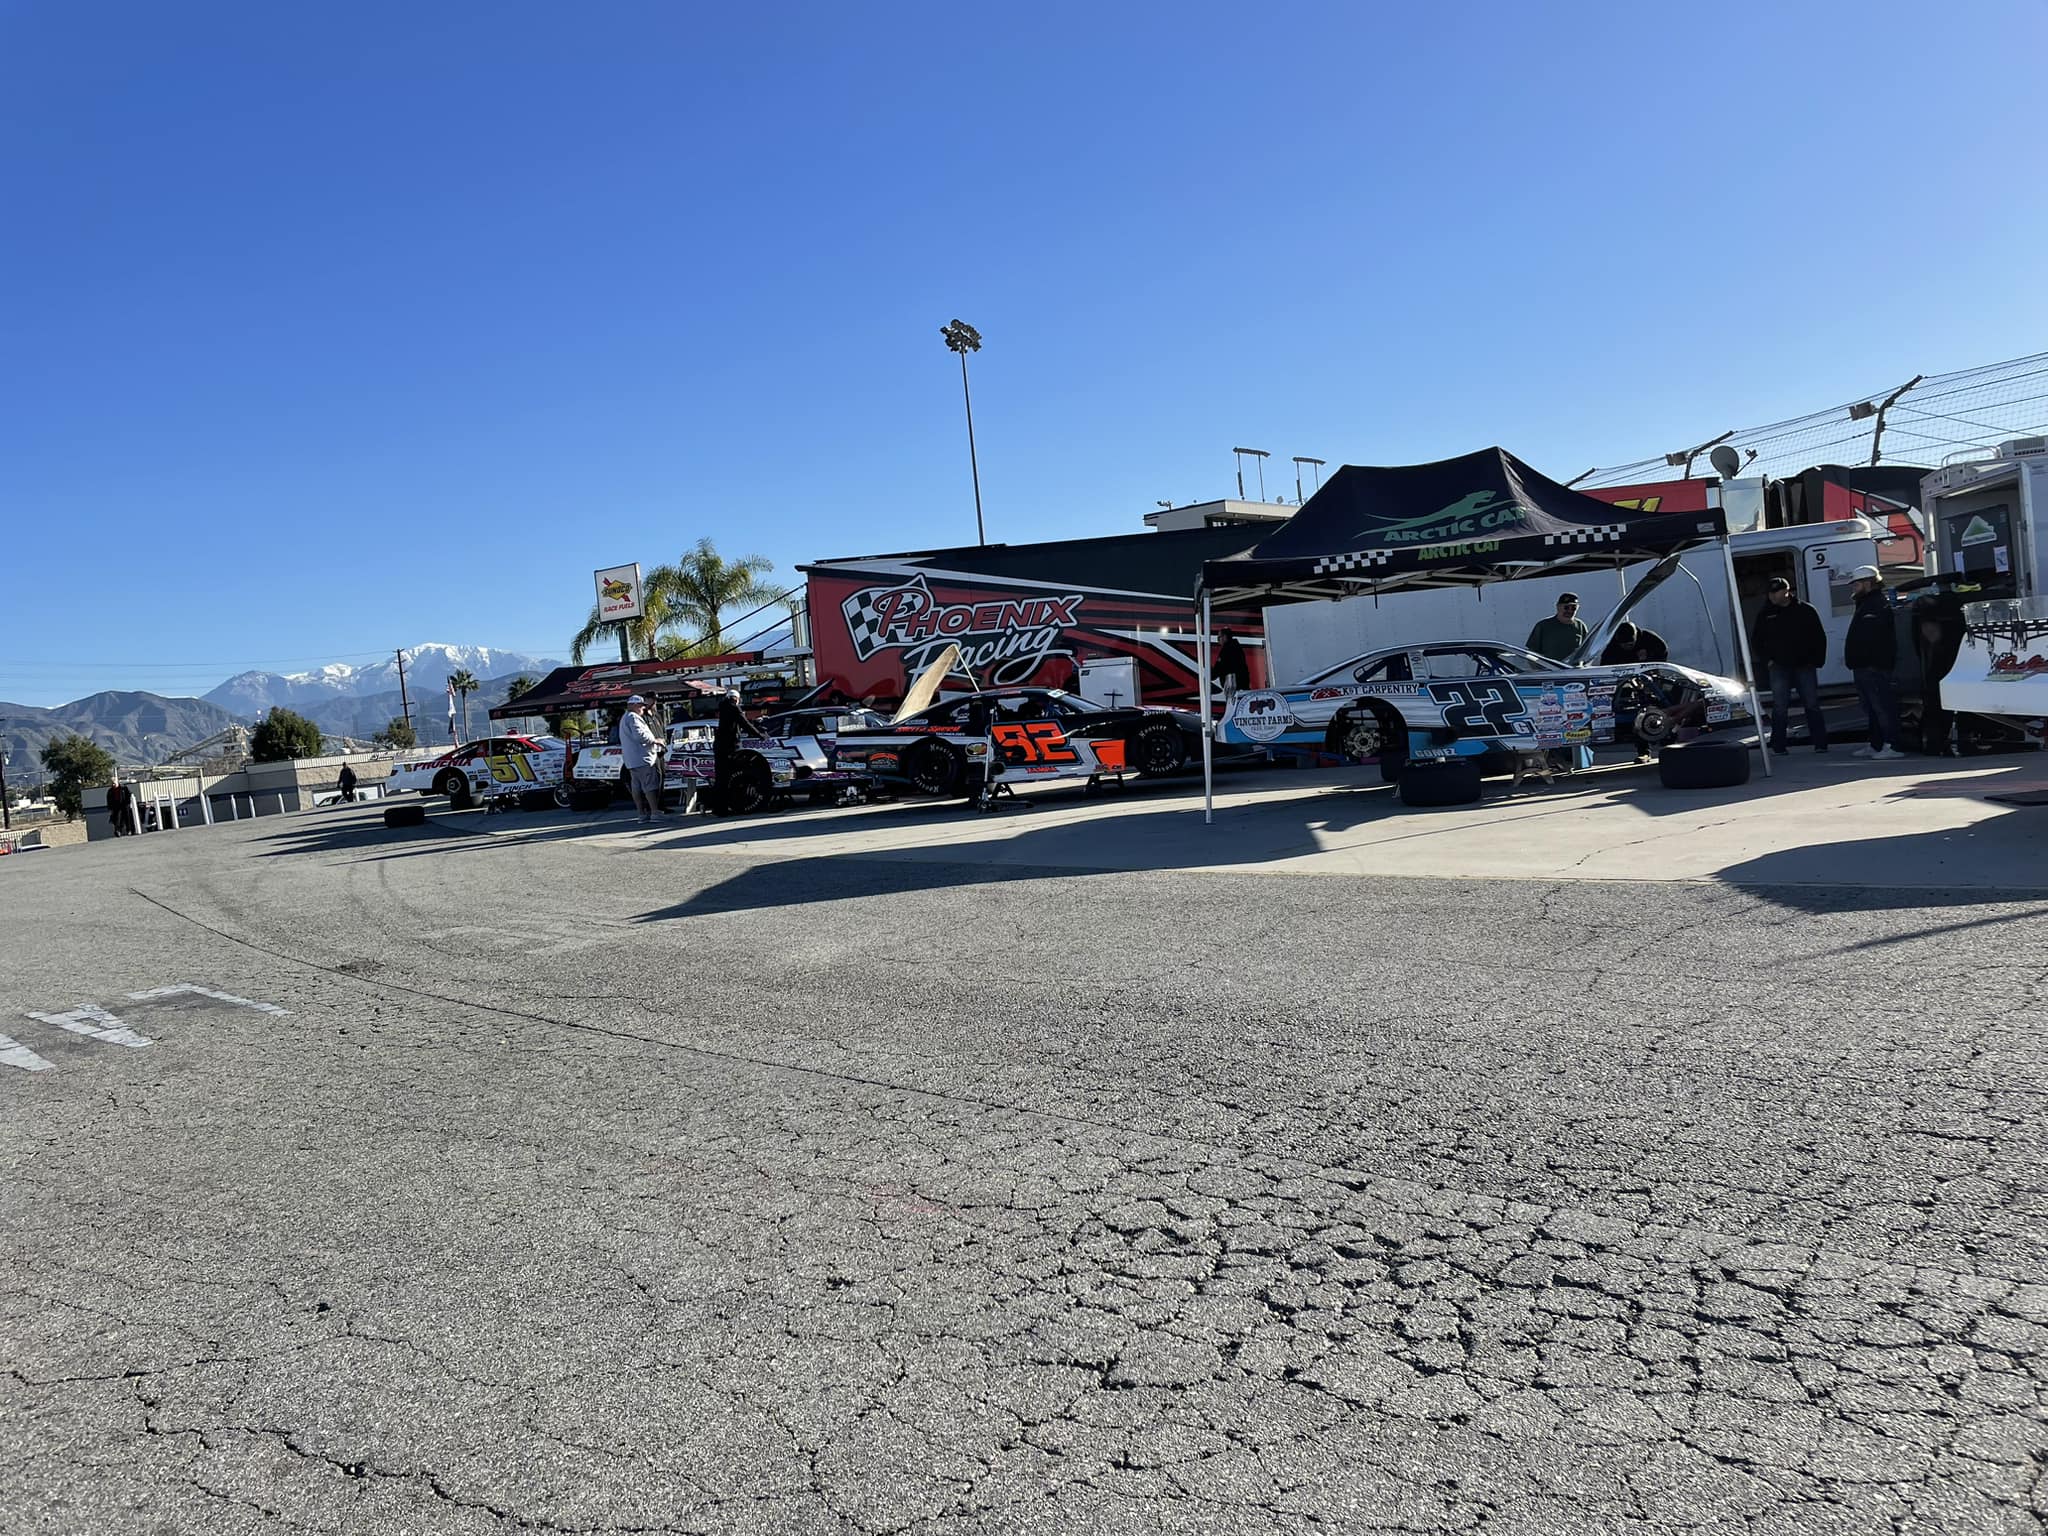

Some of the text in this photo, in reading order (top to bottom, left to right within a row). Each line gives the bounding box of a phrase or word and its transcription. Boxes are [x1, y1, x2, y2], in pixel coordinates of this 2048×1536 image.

[1384, 506, 1527, 542] ARCTIC CAT
[1418, 543, 1471, 560] ARCTIC
[1815, 553, 1826, 565] 9
[601, 583, 633, 597] SUNOCO
[619, 602, 635, 610] FUELS
[871, 588, 1079, 637] PHOENIX
[904, 627, 1073, 690] Racing
[1361, 684, 1419, 695] CARPENTRY
[1427, 679, 1538, 739] 22
[1234, 714, 1293, 727] VINCENT FARMS
[413, 757, 473, 772] PHOENIX
[484, 754, 537, 783] 51
[502, 784, 533, 793] FINCH
